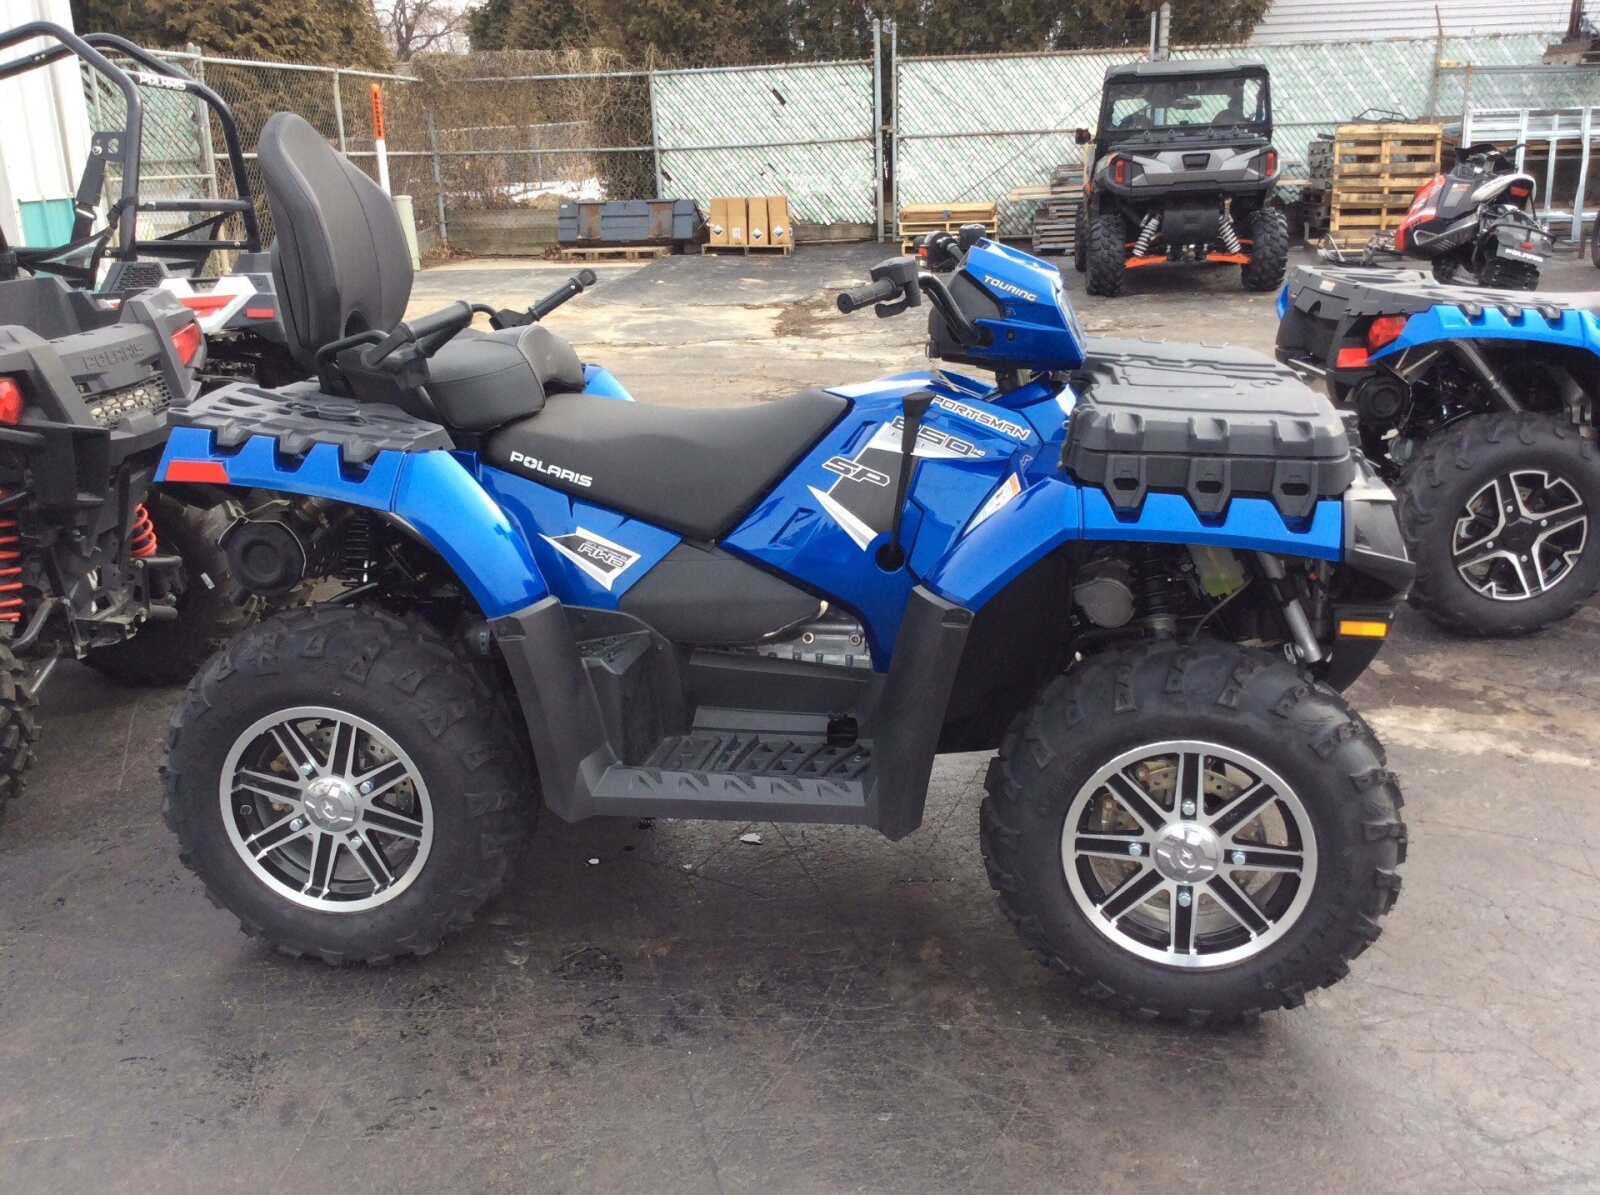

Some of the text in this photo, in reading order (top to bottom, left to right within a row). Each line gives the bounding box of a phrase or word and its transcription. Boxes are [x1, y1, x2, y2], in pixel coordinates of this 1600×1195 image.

[984, 274, 1038, 302] TOURING
[931, 394, 1032, 441] PORTSMAN
[510, 451, 593, 488] POLARIS
[822, 456, 890, 487] SP
